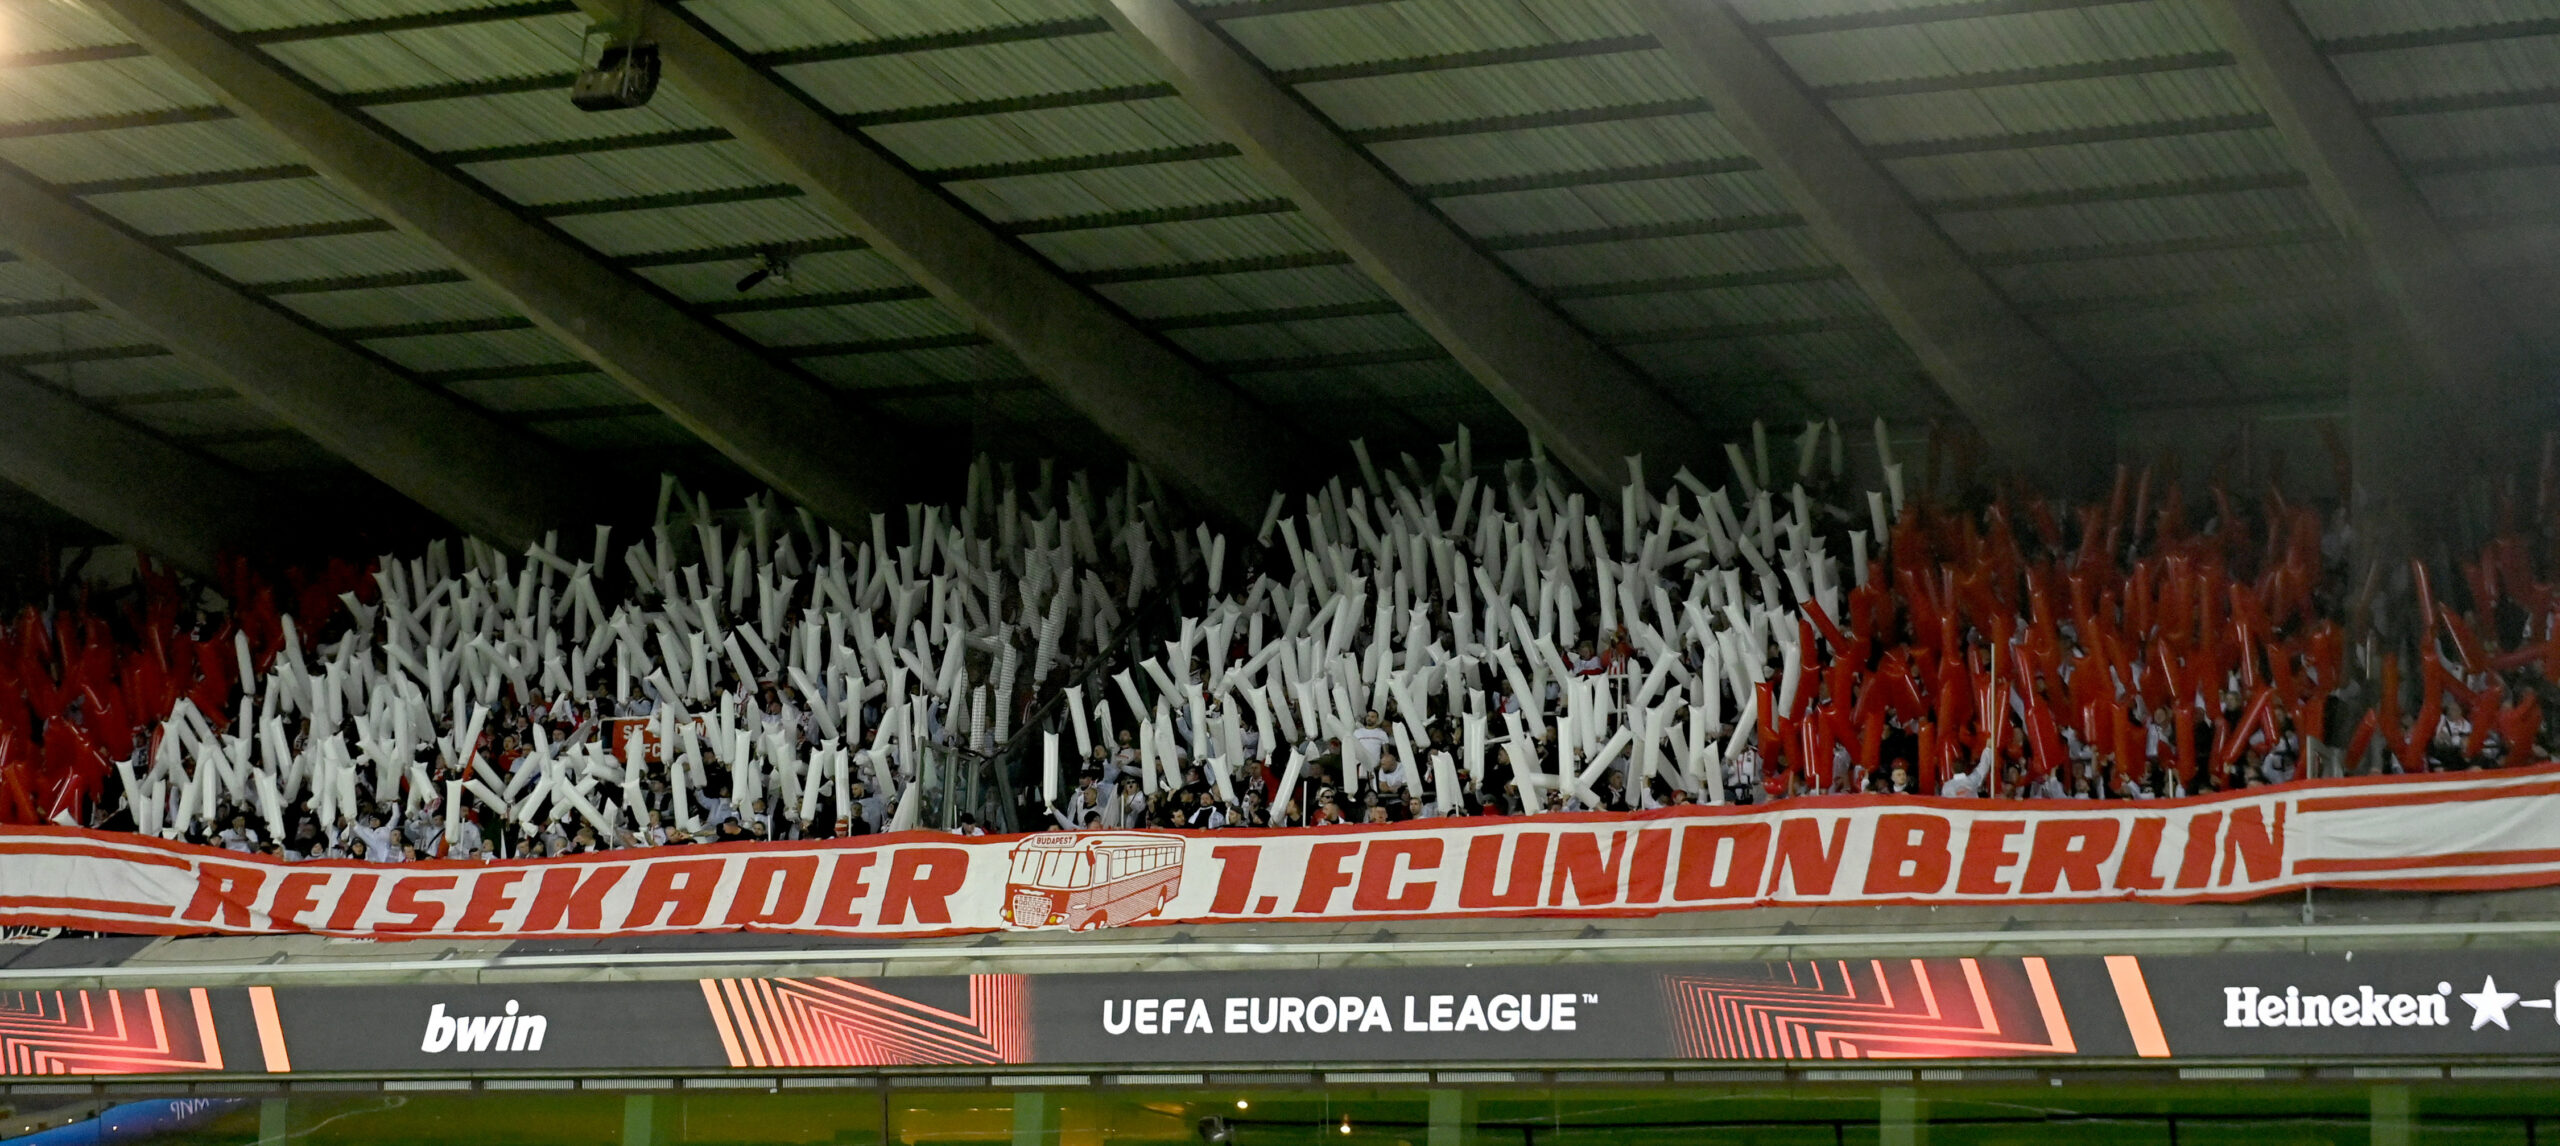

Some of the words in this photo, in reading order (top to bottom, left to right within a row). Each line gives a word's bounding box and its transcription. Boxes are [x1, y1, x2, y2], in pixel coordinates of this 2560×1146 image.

[1036, 836, 1073, 845] BUDAPEST
[1459, 818, 1851, 908] UNION
[1864, 802, 2287, 894] BERLIN
[181, 848, 970, 932] REISEKADER
[421, 1000, 547, 1053] bwin
[1103, 999, 1213, 1035] UEFA
[1225, 996, 1393, 1034] EUROPA
[2224, 986, 2450, 1027] Heineken
